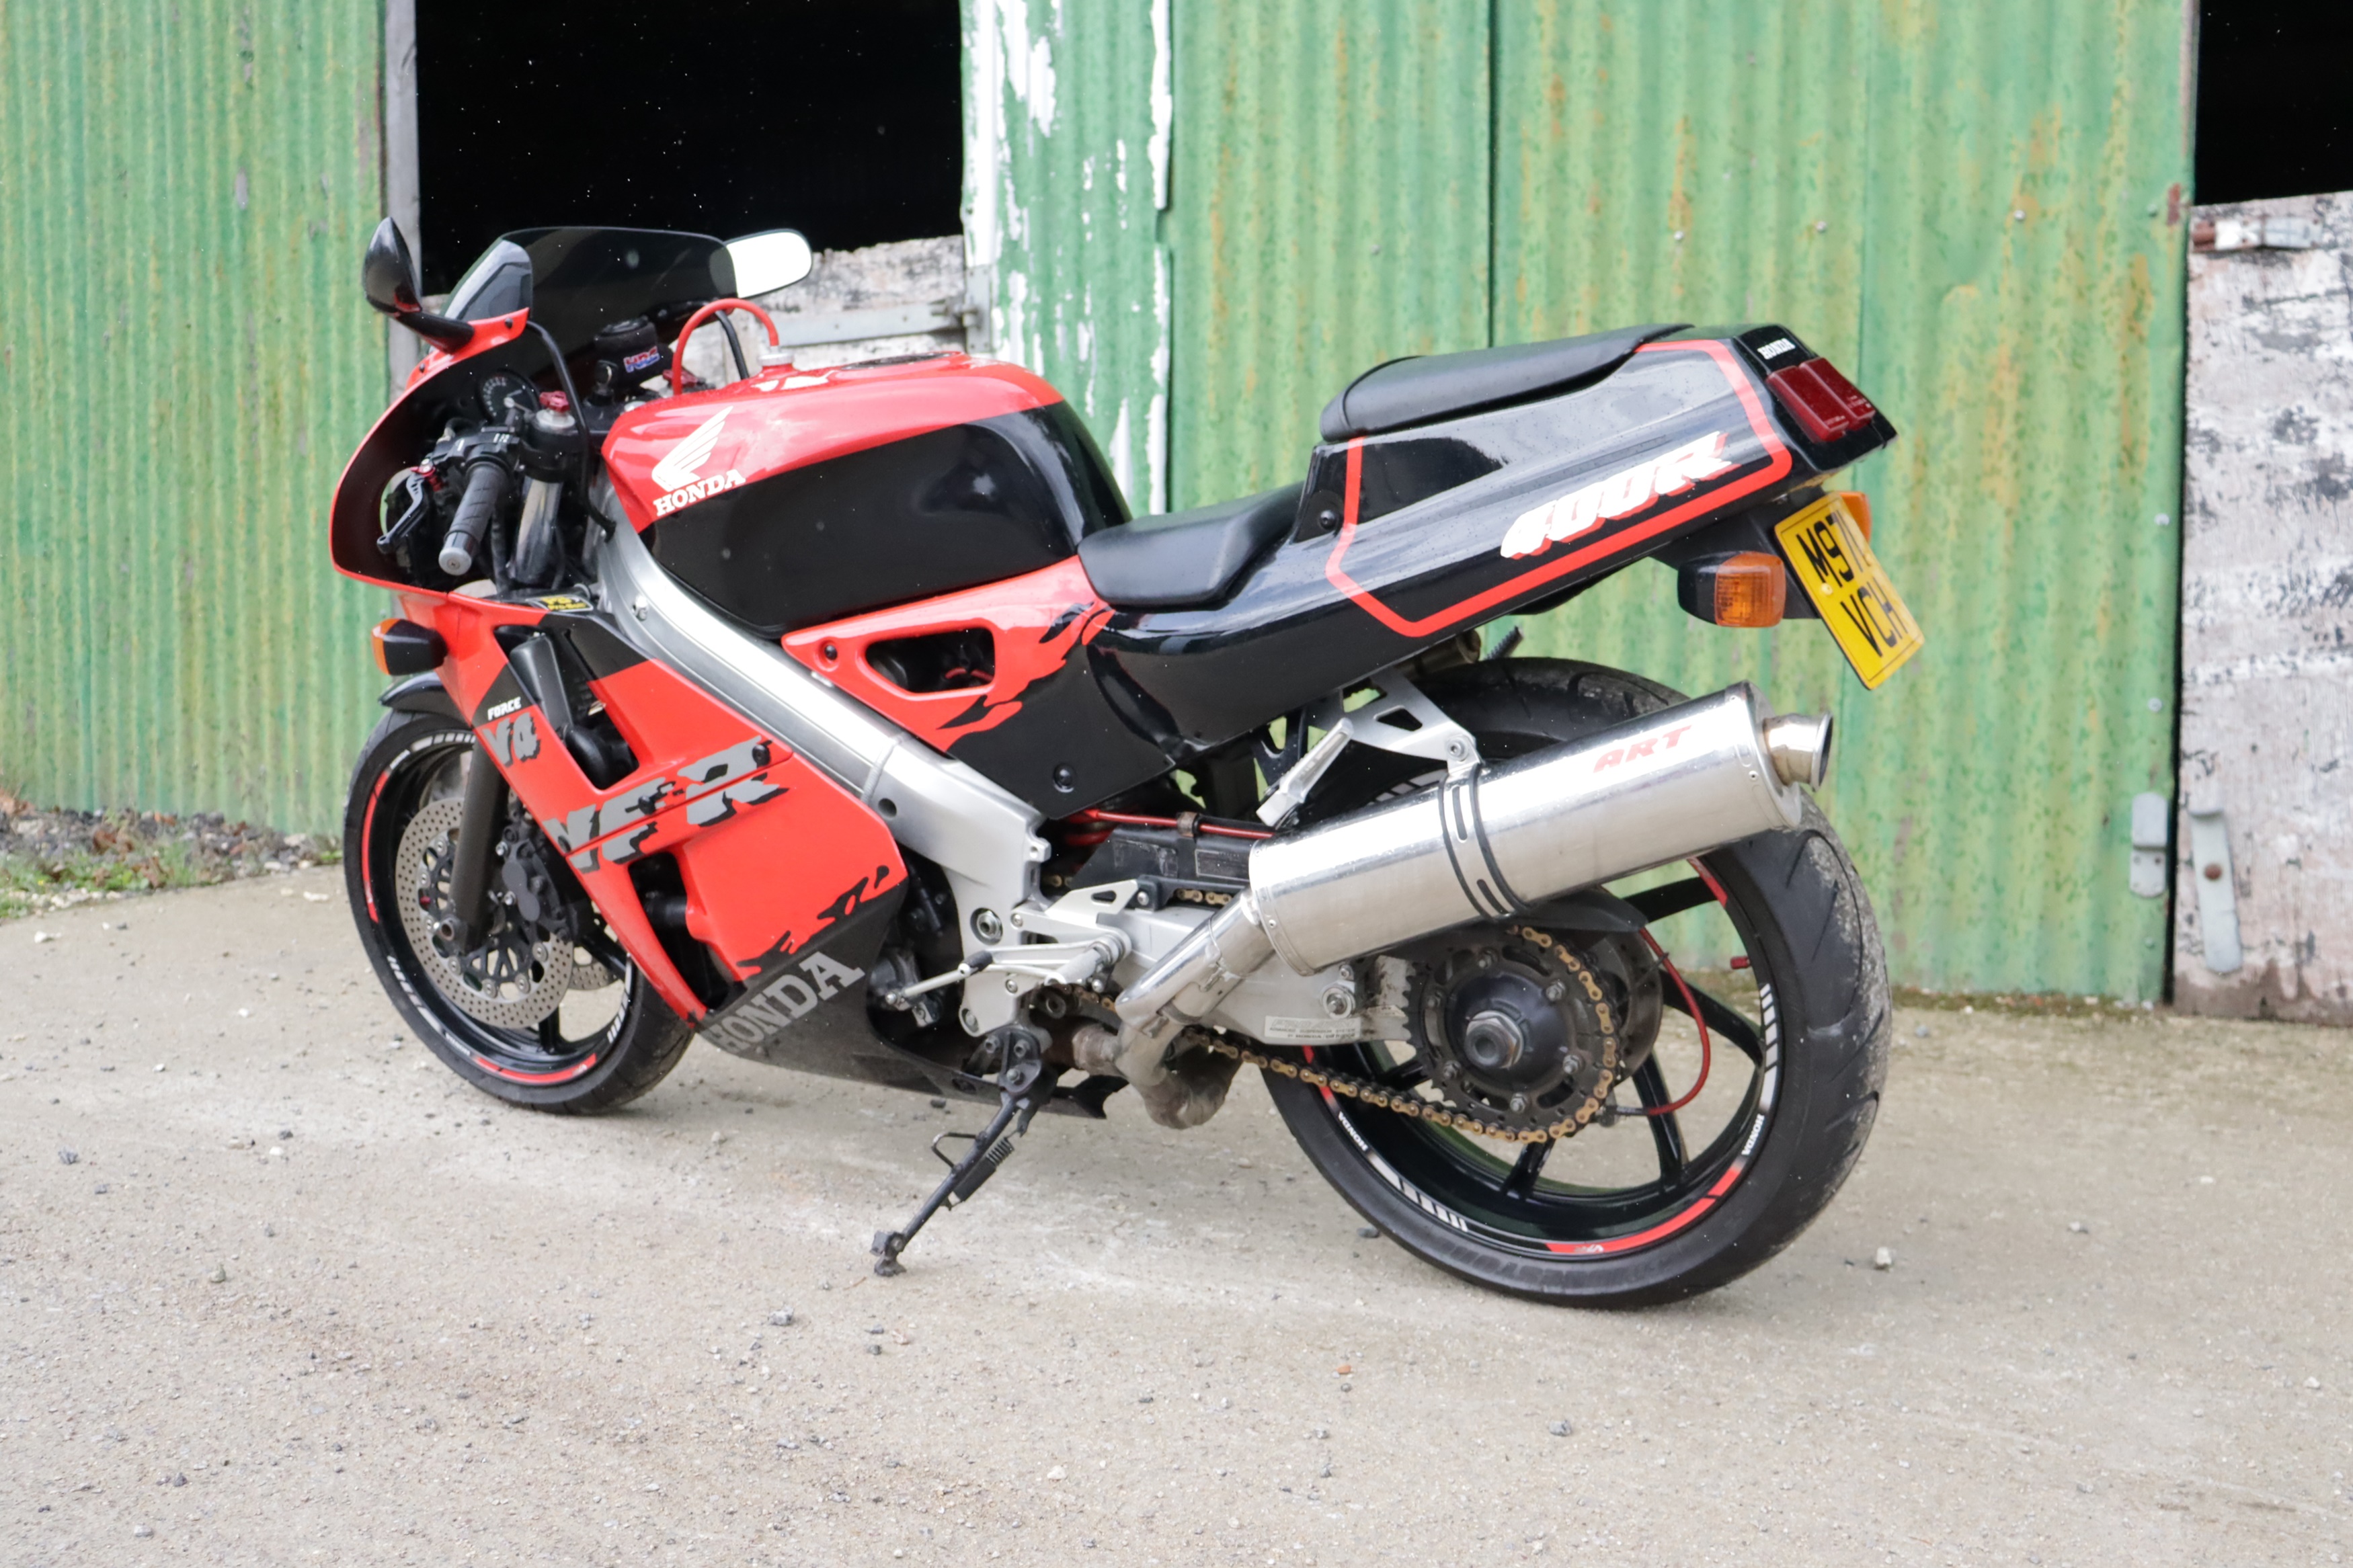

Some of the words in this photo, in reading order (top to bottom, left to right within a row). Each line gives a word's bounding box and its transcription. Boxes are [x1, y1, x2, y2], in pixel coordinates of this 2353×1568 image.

[623, 345, 660, 373] HRC
[1757, 338, 1796, 360] HONDA
[653, 468, 746, 517] HONDA
[1501, 431, 1740, 560] 400R
[1840, 577, 1909, 657] VCH
[487, 696, 522, 721] FORCE
[481, 712, 541, 768] V4
[1593, 725, 1692, 774] ART
[541, 735, 789, 874] VFR
[709, 951, 866, 1054] HONDA
[1338, 1110, 1368, 1151] HONDA
[1741, 1113, 1765, 1155] HONDA
